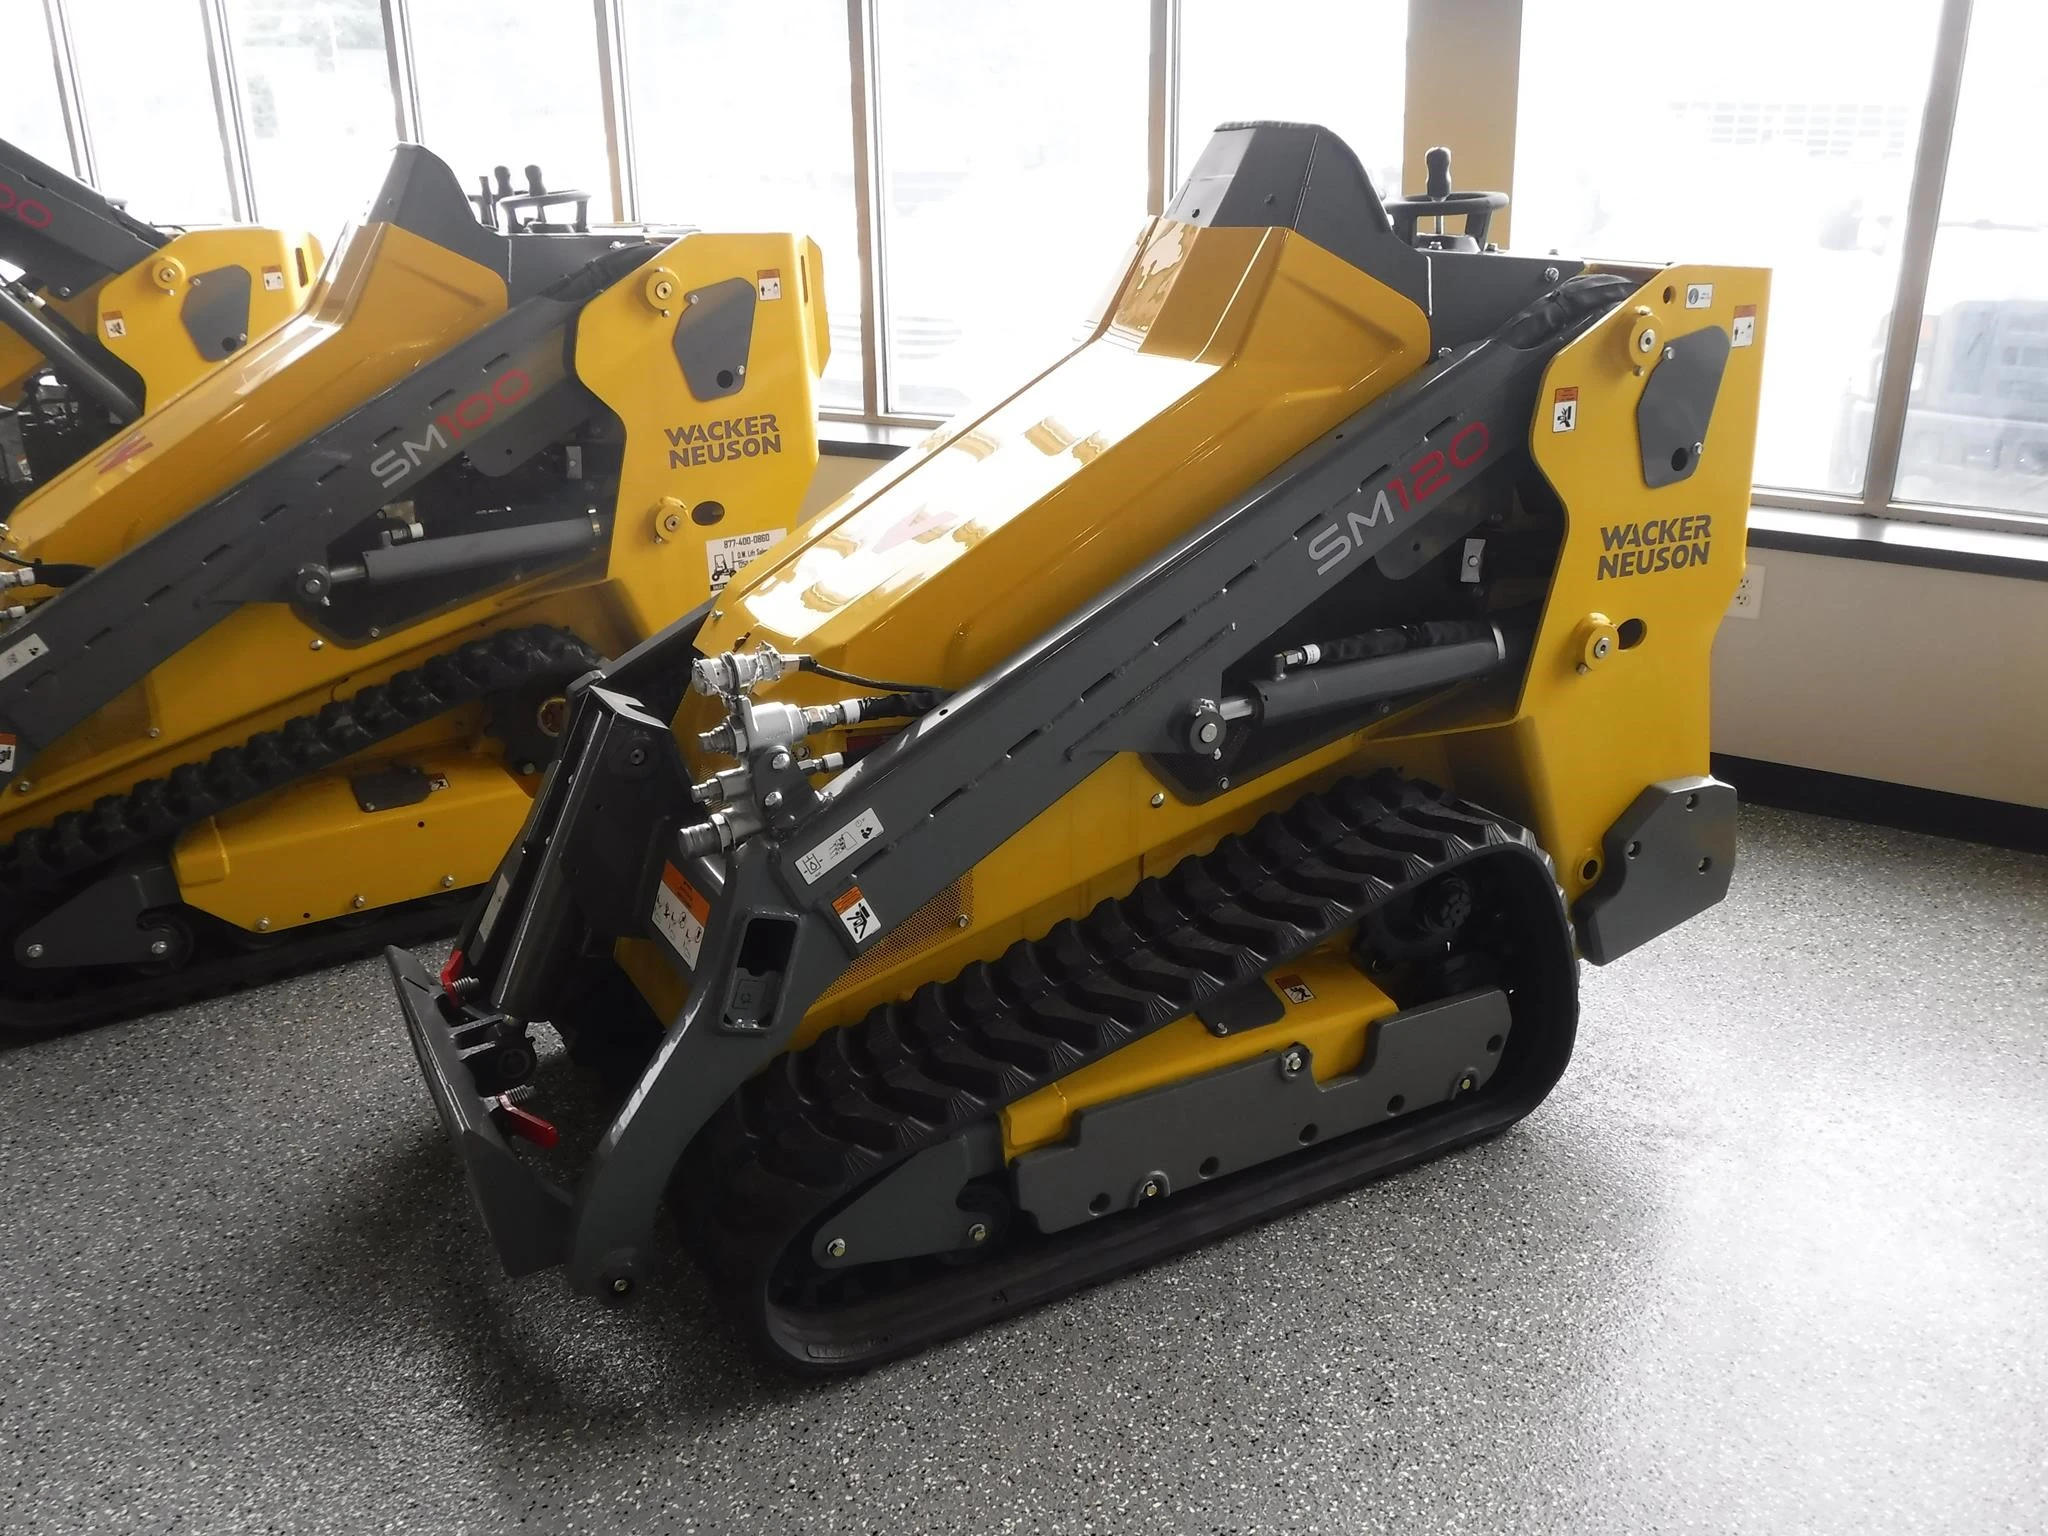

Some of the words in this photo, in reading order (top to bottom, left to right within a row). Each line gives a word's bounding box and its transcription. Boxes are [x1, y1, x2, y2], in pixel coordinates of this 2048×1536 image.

[370, 369, 531, 489] SM100
[664, 414, 780, 447] WACKER
[669, 434, 781, 470] NEUSON
[1308, 421, 1490, 576] SM120
[1600, 514, 1712, 551] WACKER
[1597, 541, 1711, 580] NEUSON
